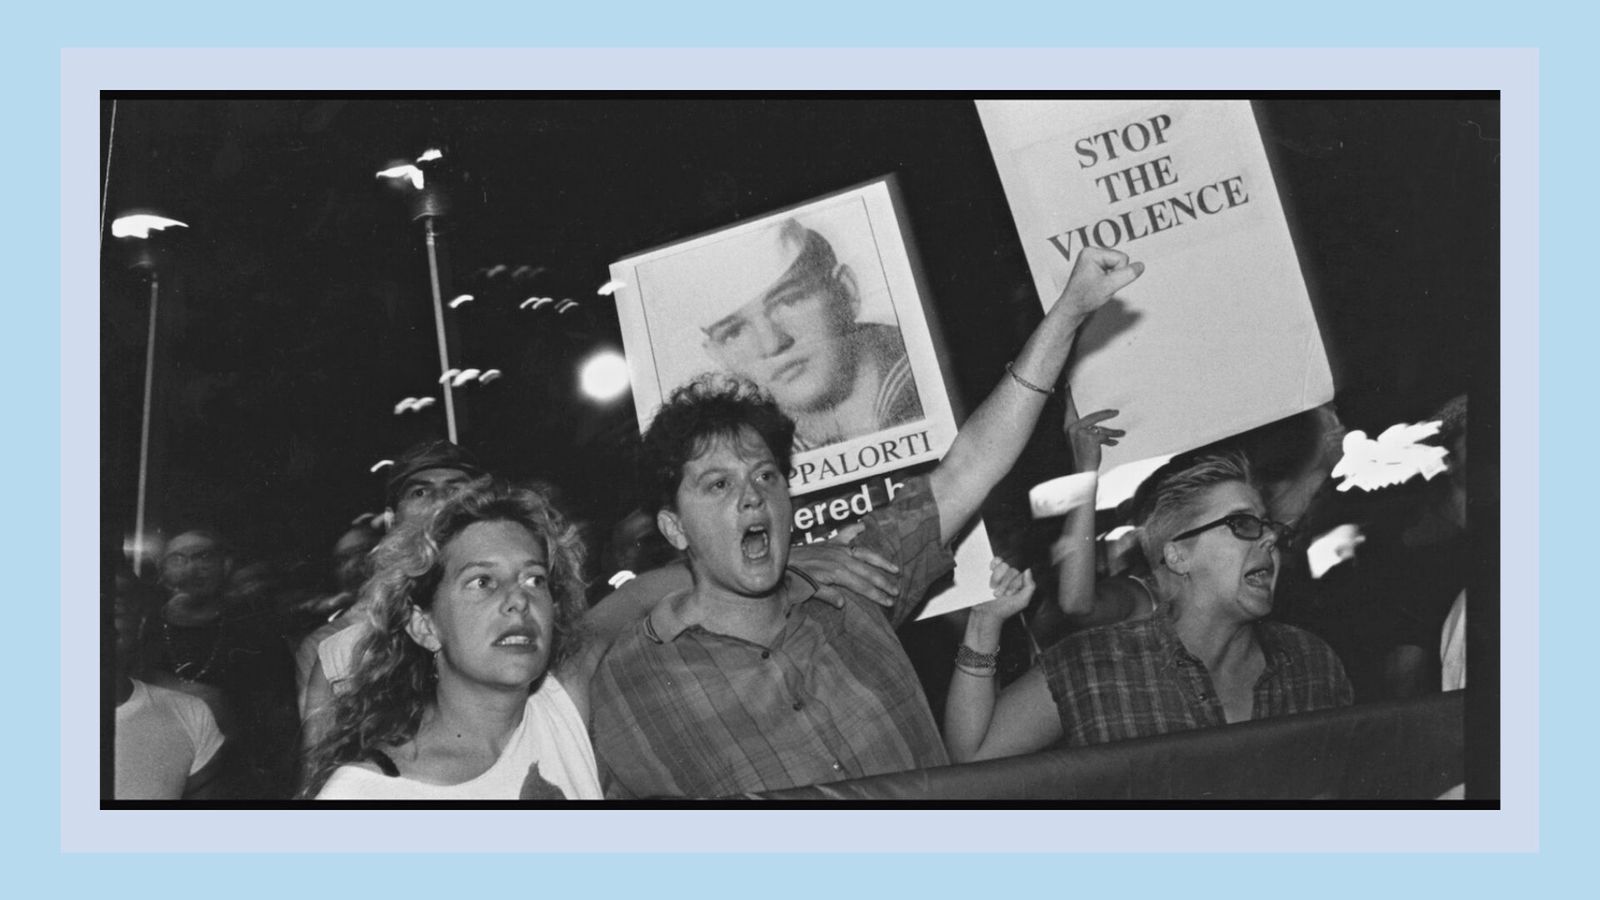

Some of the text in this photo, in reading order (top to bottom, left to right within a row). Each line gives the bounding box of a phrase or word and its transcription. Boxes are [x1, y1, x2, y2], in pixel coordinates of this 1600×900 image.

[1074, 114, 1171, 169] STOP
[1095, 155, 1179, 204] THE
[1047, 175, 1249, 262] VIOLENCE
[790, 484, 873, 532] ered
